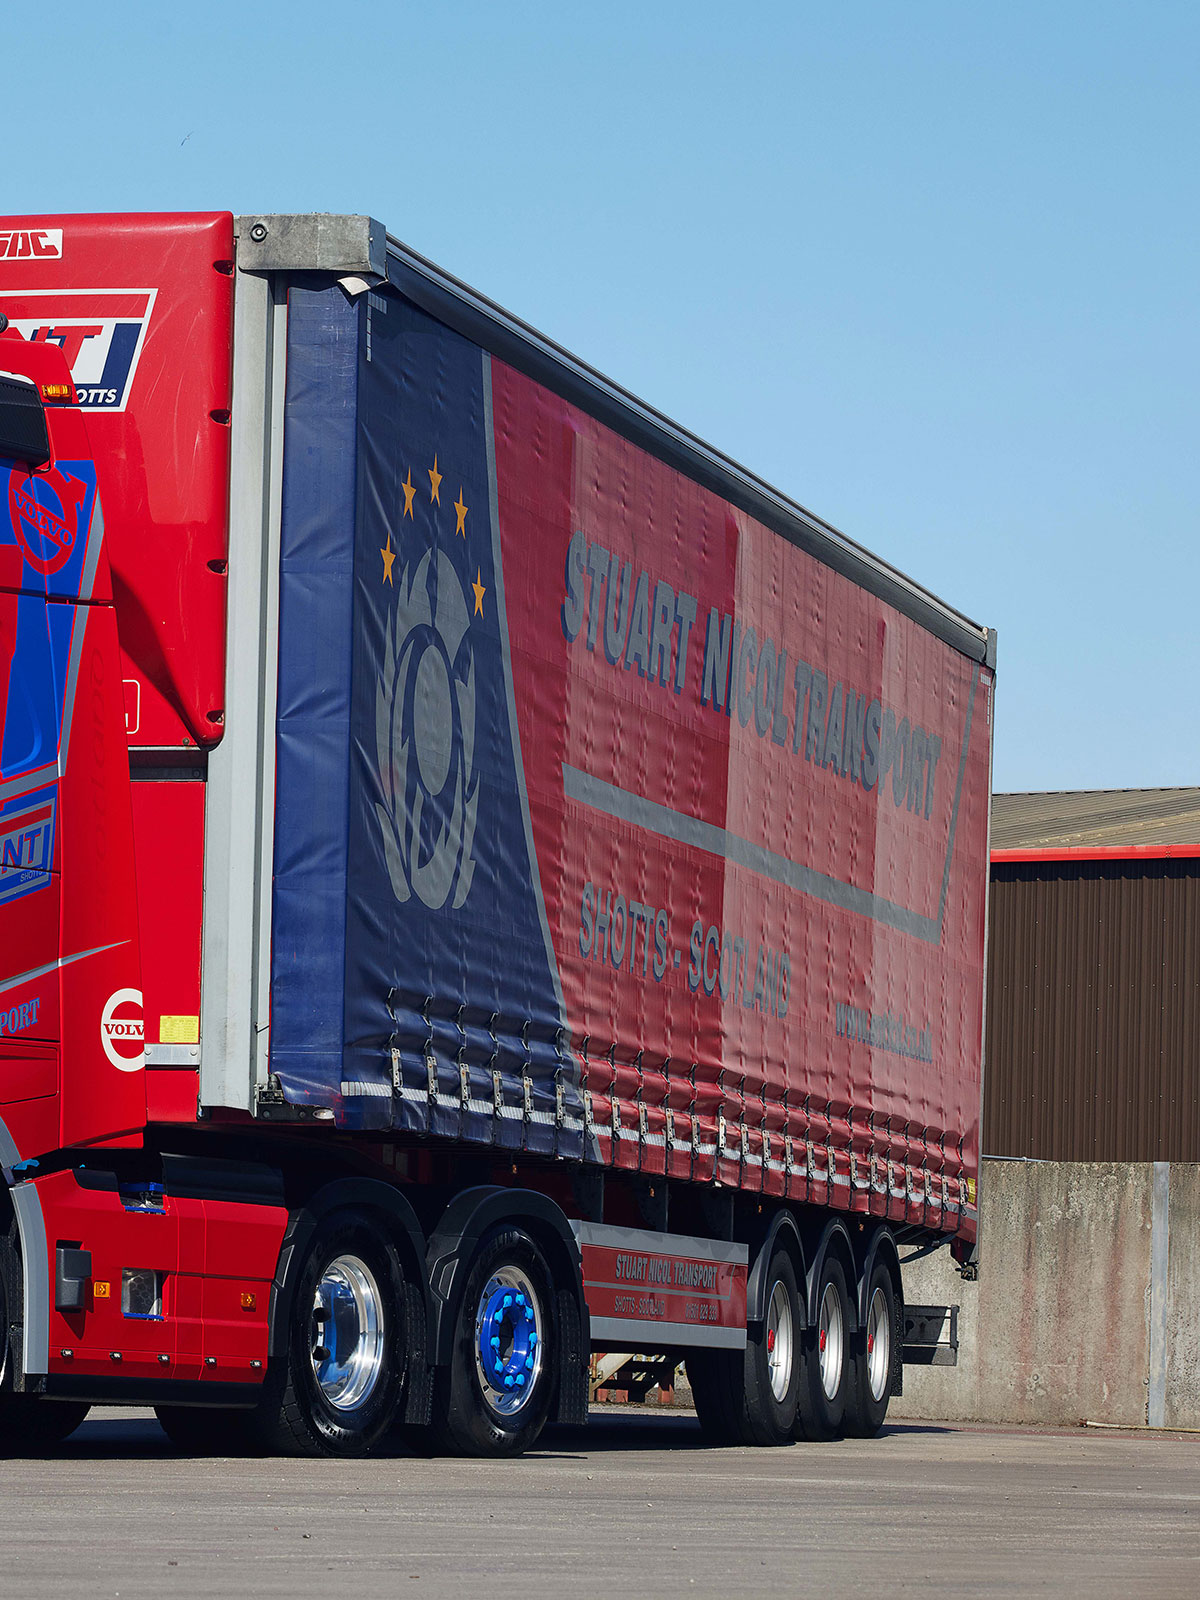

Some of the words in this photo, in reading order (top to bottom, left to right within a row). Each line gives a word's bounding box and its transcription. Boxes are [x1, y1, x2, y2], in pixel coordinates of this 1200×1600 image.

[76, 388, 118, 404] OTTS
[12, 488, 73, 547] VOLVO
[561, 530, 697, 695] STUART
[700, 606, 791, 748] NICOL
[791, 658, 943, 821] TRANSPORT
[578, 880, 669, 984] SHOTTS
[687, 918, 791, 1021] SCOTLAND
[103, 1023, 144, 1036] VOLV
[615, 1253, 648, 1281] STUART
[648, 1258, 672, 1284] NICOL
[674, 1262, 718, 1290] TRANSPORT
[614, 1295, 635, 1314] SHOTTS
[638, 1298, 665, 1317] SCOTLAND
